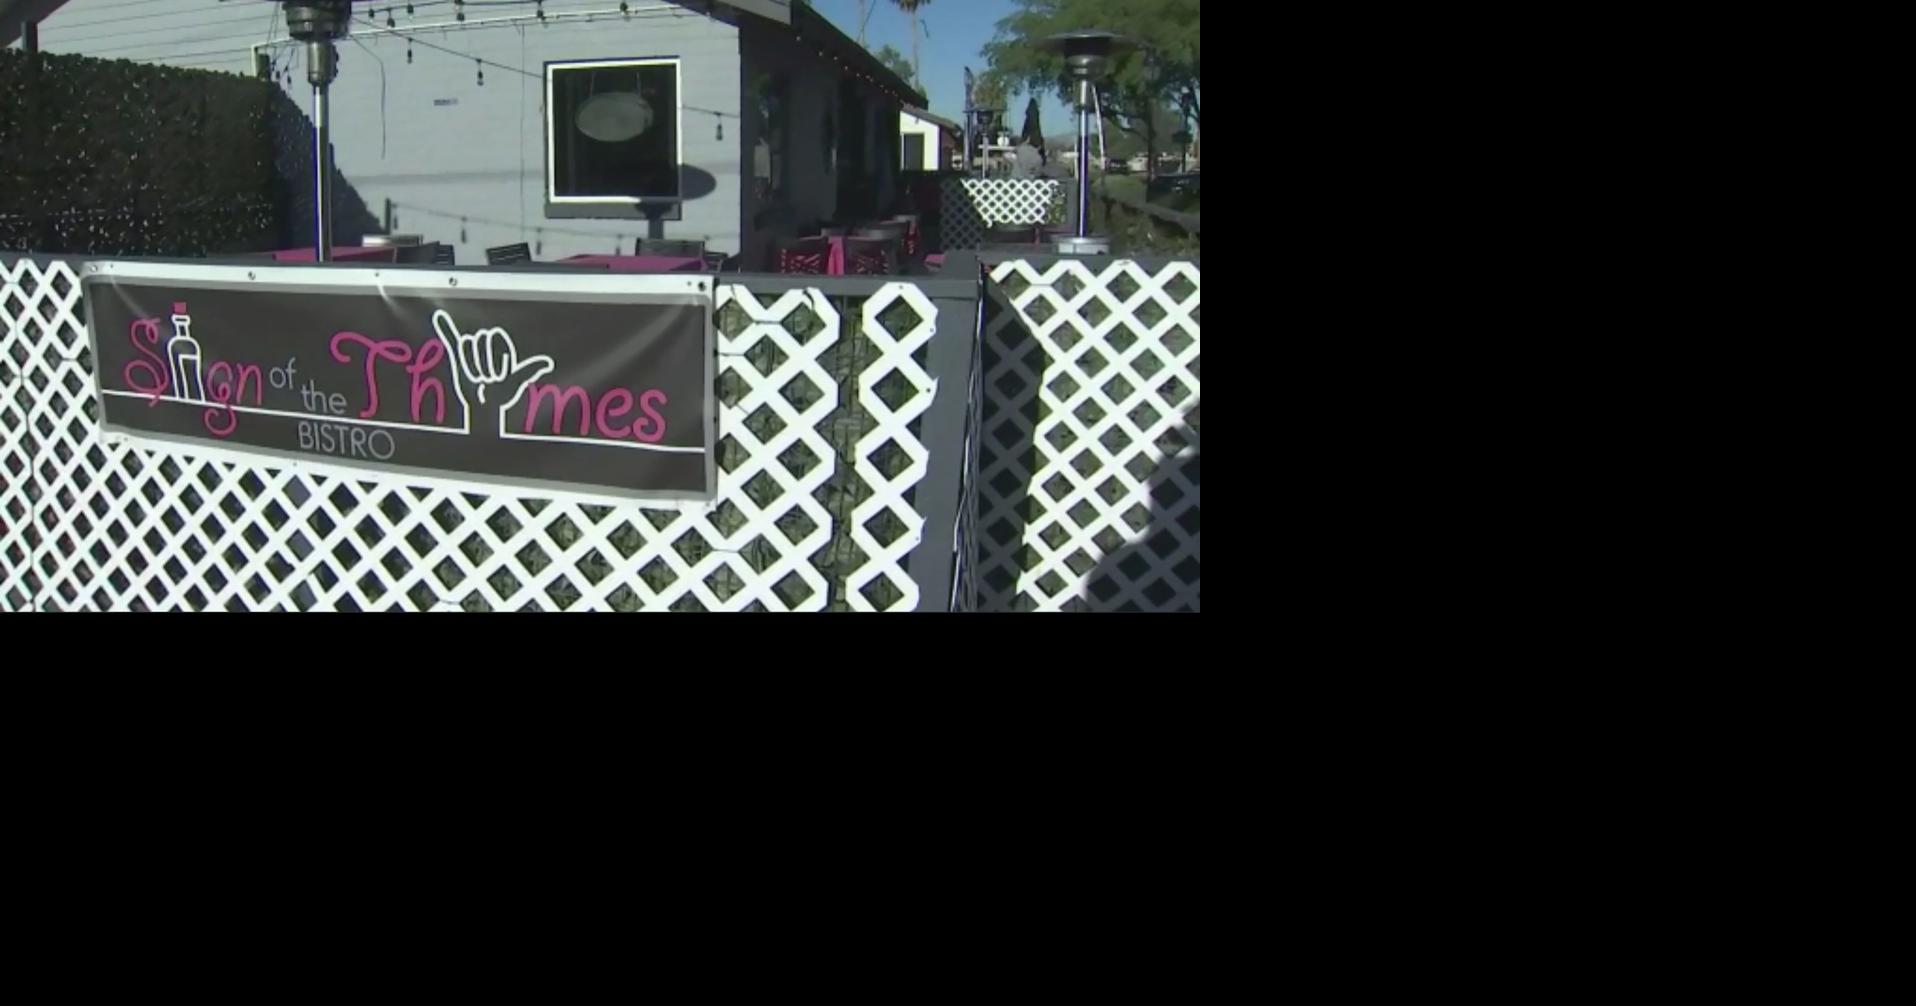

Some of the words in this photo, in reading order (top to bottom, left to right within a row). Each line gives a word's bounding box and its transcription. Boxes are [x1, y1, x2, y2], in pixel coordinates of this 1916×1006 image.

[269, 357, 296, 389] of
[301, 380, 347, 415] the
[298, 421, 396, 460] BISTRO
